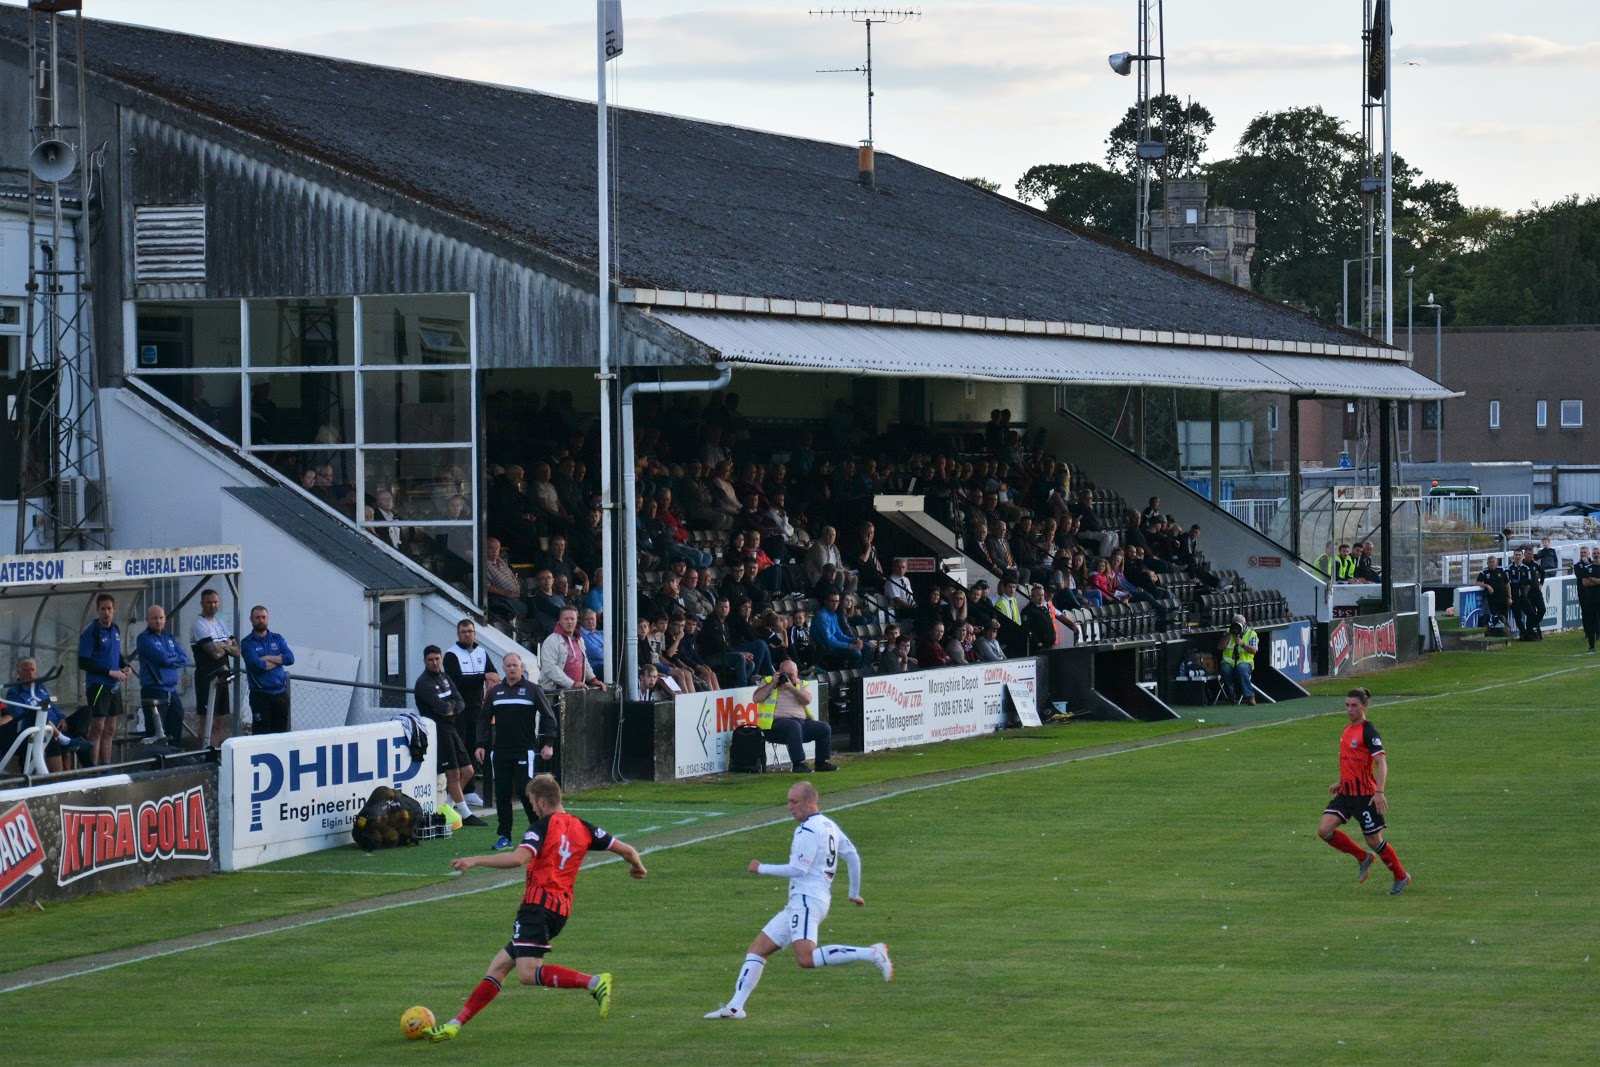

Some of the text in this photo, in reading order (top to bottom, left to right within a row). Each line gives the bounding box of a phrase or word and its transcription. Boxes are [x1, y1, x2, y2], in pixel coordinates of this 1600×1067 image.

[0, 560, 64, 582] ATERSON
[94, 560, 112, 571] HOME
[125, 553, 239, 577] GENERAL ENGINEERS
[1333, 626, 1348, 658] BARR
[1289, 646, 1300, 667] CUP
[866, 680, 909, 709] CONTRAFLOW
[929, 675, 978, 696] Morayshire Depot
[934, 698, 973, 717] 01309 676 504
[984, 700, 1001, 716] Traffic
[866, 711, 923, 732] Traffic Management
[931, 722, 977, 738] www.contraflow.co.uk
[413, 784, 431, 798] 01343
[280, 793, 366, 823] Engineerin
[1362, 811, 1372, 824] 3
[322, 817, 342, 829] Elgin
[0, 814, 37, 875] ARR
[62, 793, 208, 877] XTRA COLA
[558, 834, 572, 869] 4
[826, 834, 836, 867] 9
[791, 914, 799, 929] 9
